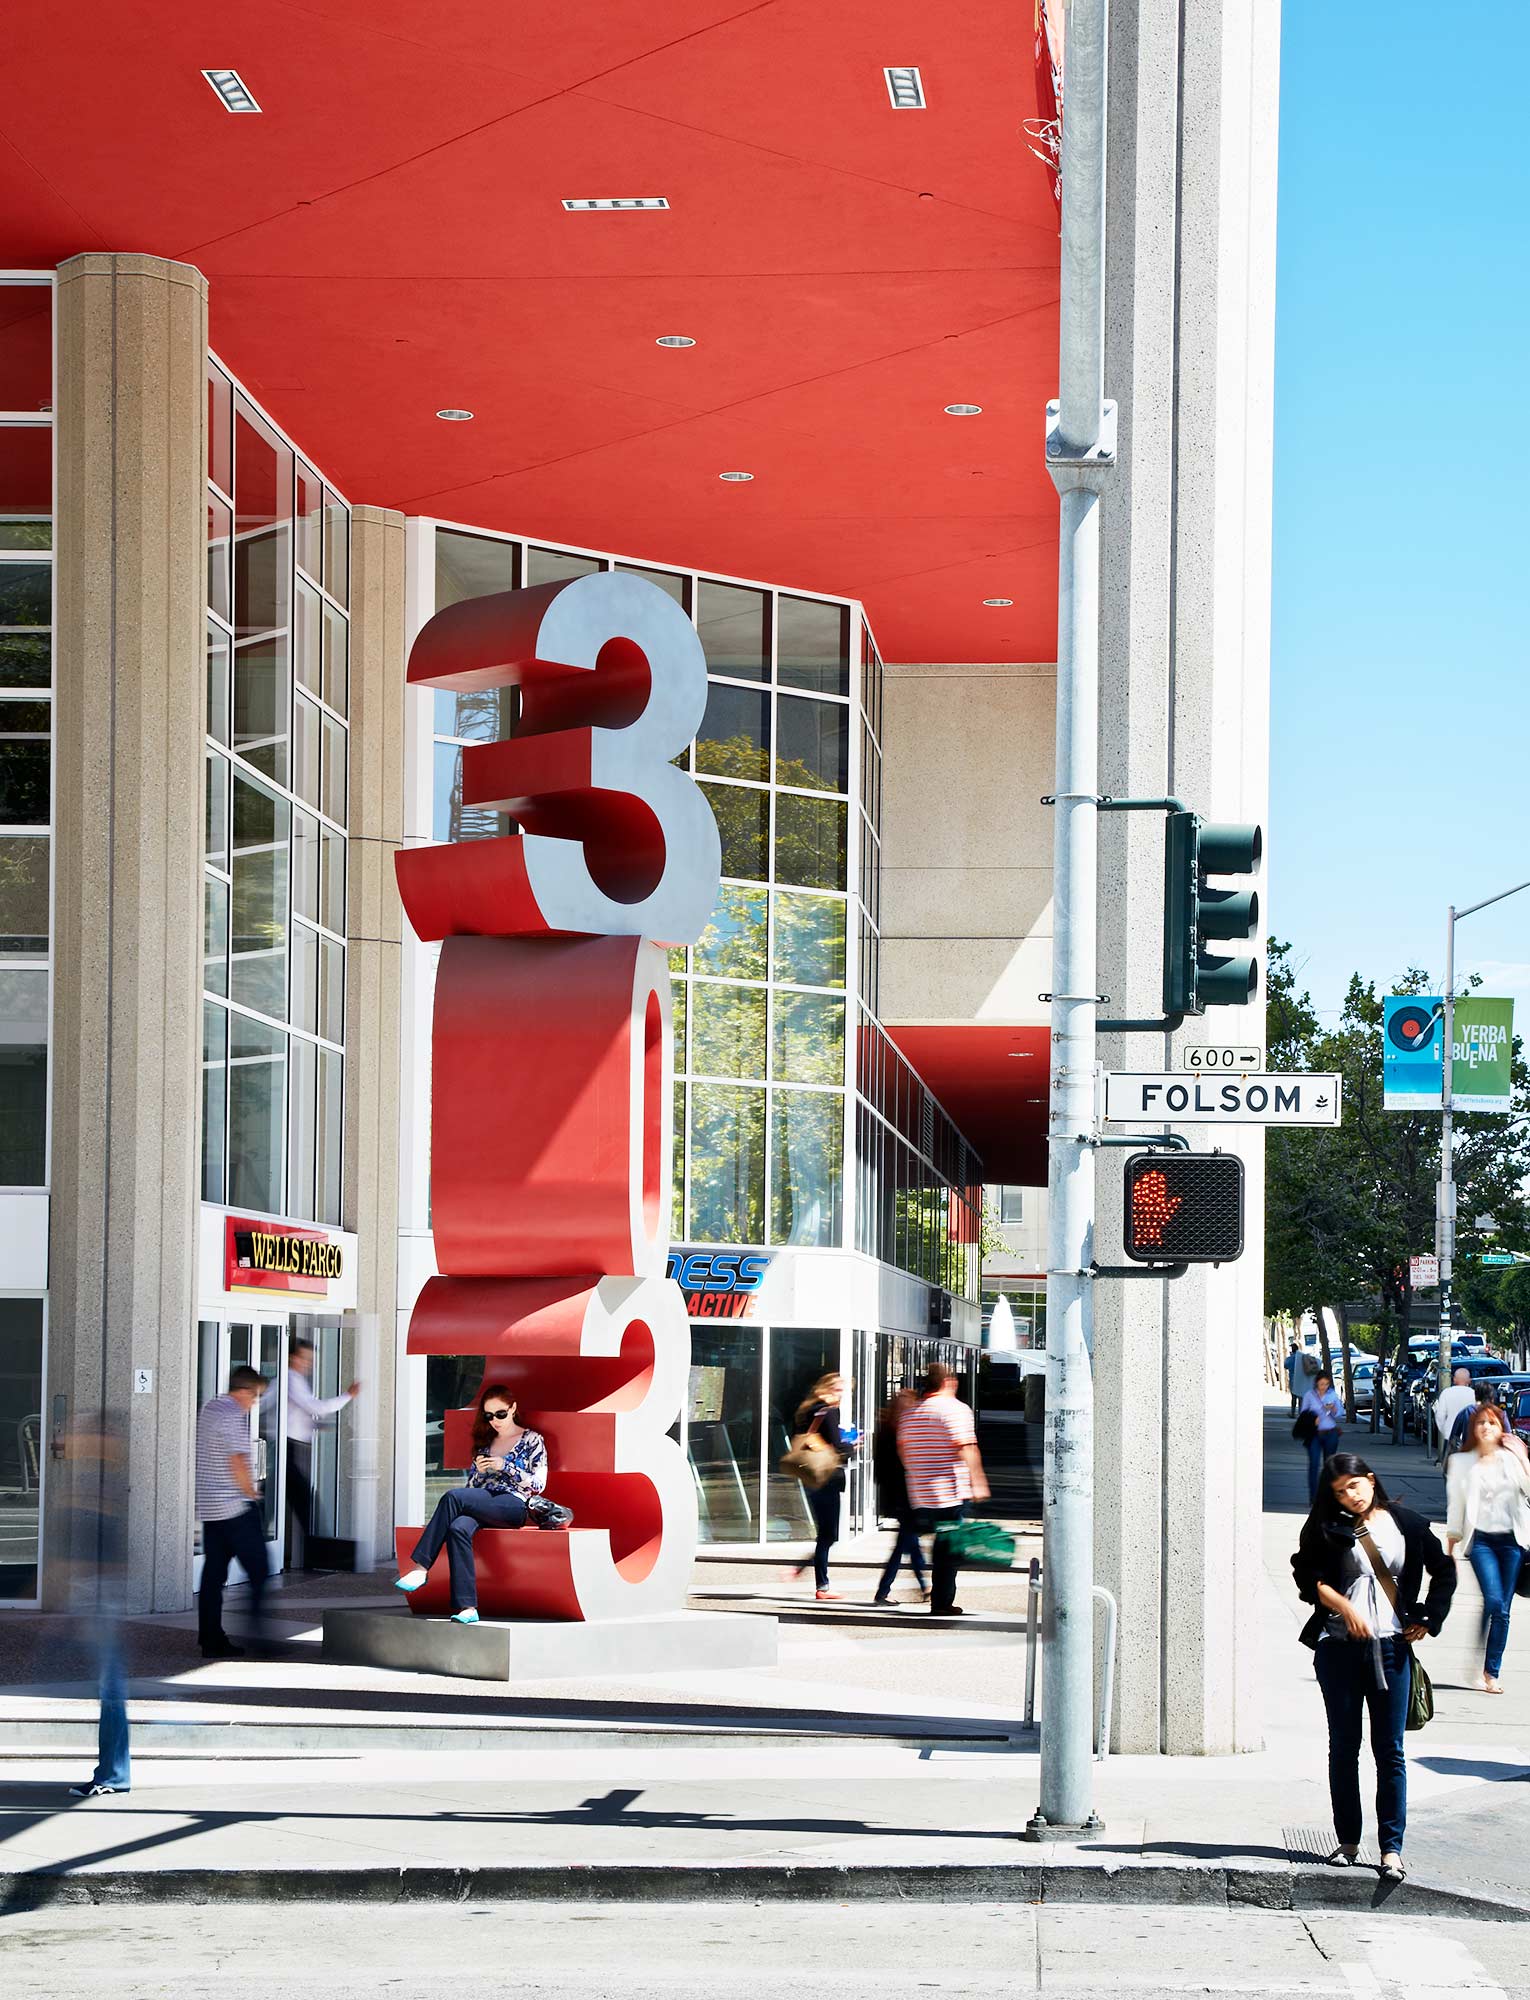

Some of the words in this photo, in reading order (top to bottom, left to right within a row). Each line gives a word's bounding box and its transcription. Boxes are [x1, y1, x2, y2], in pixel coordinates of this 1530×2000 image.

[1461, 1024, 1508, 1044] YERBA
[1190, 1049, 1235, 1067] 600
[1452, 1042, 1498, 1069] BUENA
[1141, 1084, 1301, 1113] FOLSOM
[251, 1231, 300, 1274] WELLS
[301, 1240, 343, 1279] FARGO
[687, 1292, 758, 1319] ACTIVE
